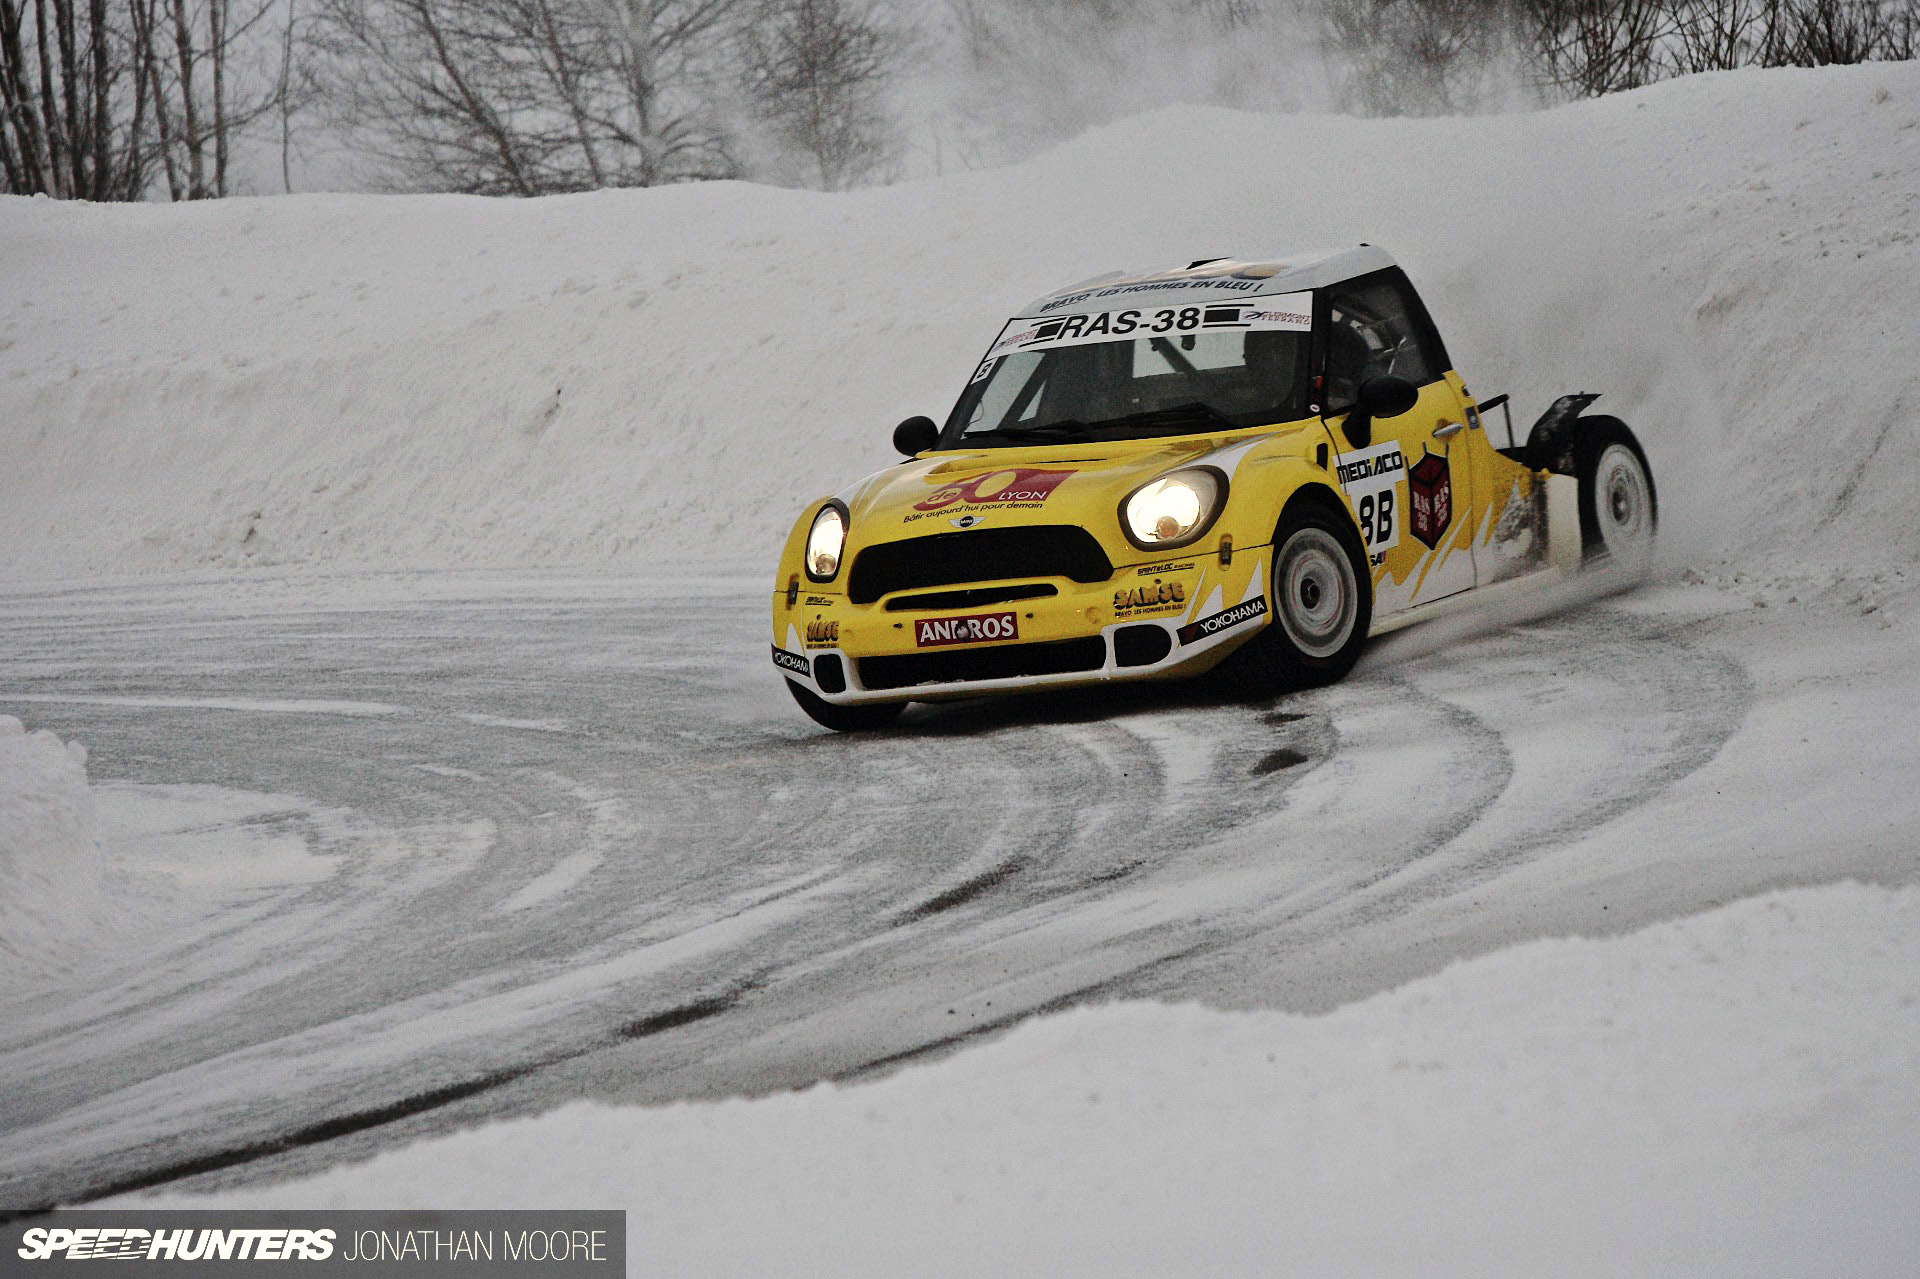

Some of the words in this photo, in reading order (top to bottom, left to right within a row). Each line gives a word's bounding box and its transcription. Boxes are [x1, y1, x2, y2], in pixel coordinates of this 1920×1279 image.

[1122, 282, 1191, 293] HOMMES
[1215, 281, 1254, 290] BLEU
[1056, 307, 1200, 340] RAS-38
[998, 490, 1047, 500] LYON
[926, 504, 980, 517] aujourd'hui
[980, 503, 1004, 512] pour
[1006, 501, 1043, 509] demain
[1200, 600, 1265, 633] YOKOHAMA
